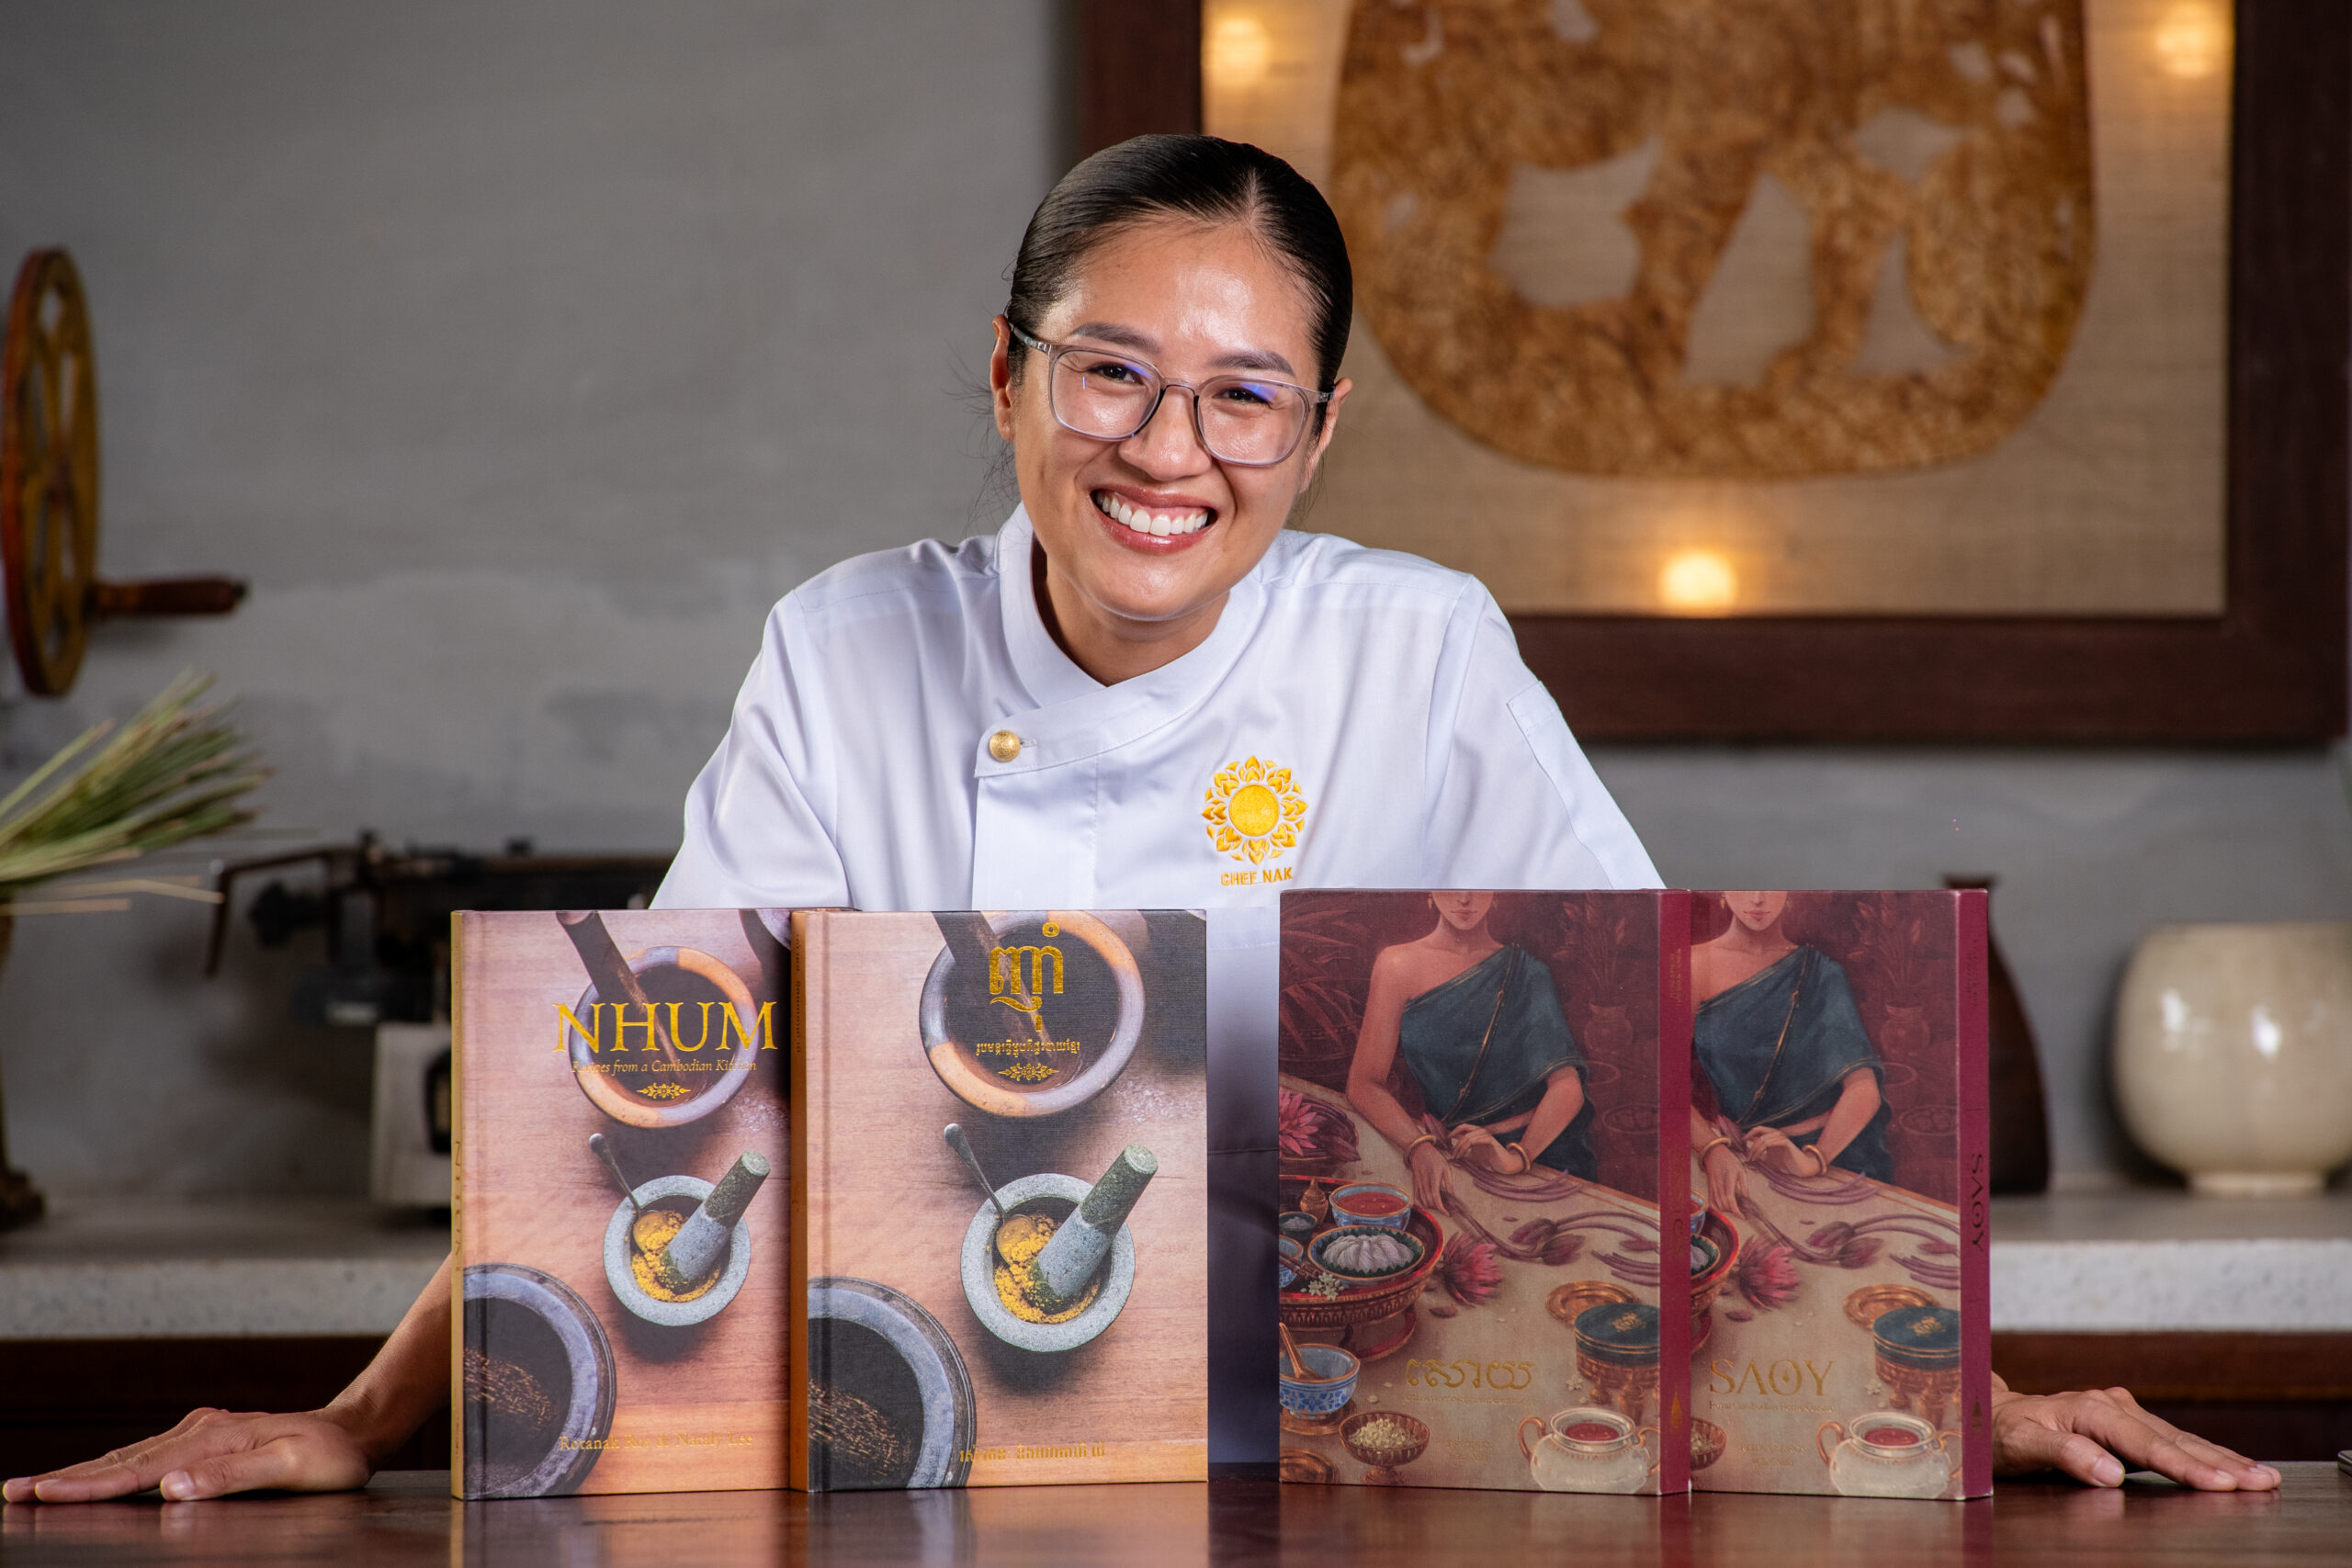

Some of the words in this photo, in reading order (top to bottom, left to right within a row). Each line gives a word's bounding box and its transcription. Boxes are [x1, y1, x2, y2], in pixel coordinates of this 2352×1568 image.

[1220, 871, 1257, 886] CHEF
[1262, 866, 1293, 883] NAK
[551, 1000, 778, 1054] NHUM
[610, 1059, 639, 1077] from
[640, 1064, 648, 1072] a
[651, 1059, 713, 1072] Cambodian
[715, 1058, 757, 1071] Kitchen
[1709, 1359, 1837, 1396] SAOY
[560, 1434, 620, 1450] Rotanak
[656, 1433, 669, 1448] &
[676, 1430, 723, 1449] Nataly
[728, 1430, 753, 1446] Lee
